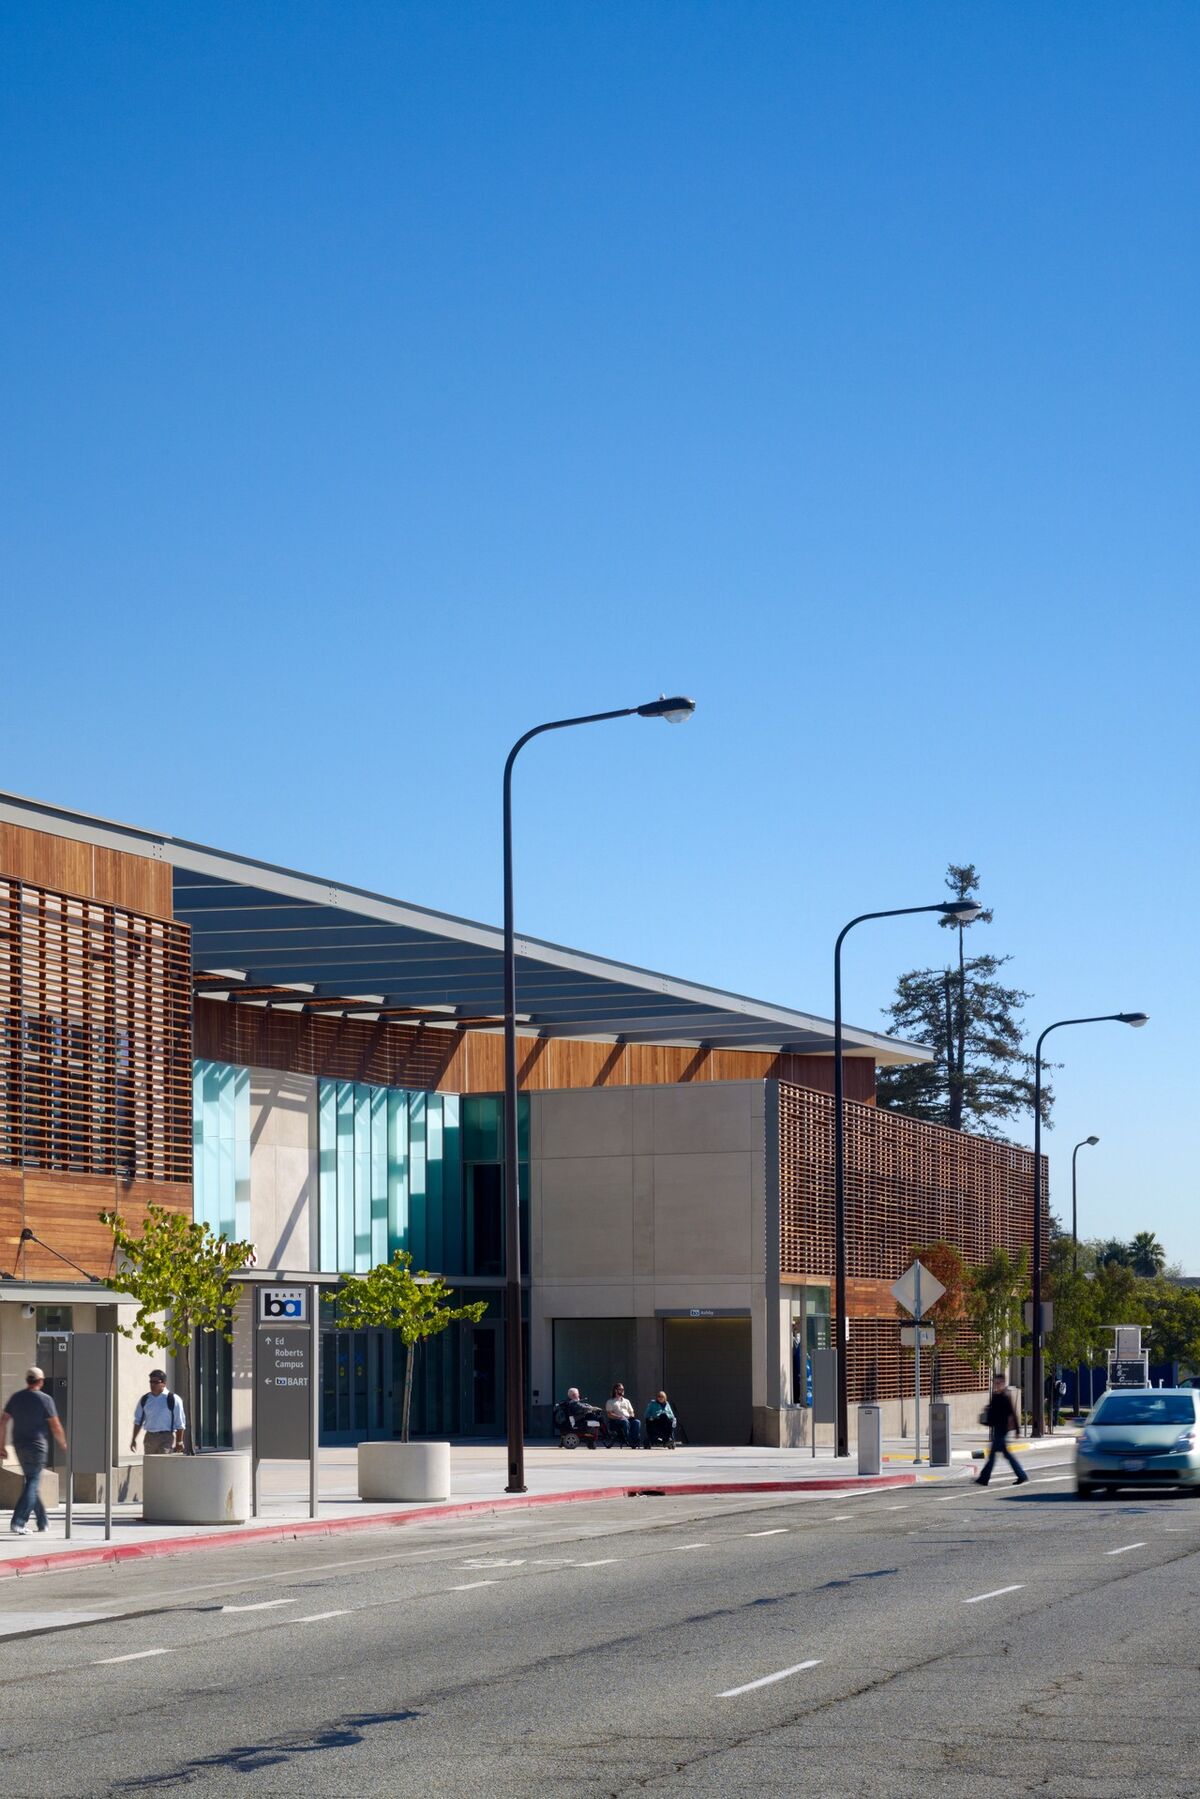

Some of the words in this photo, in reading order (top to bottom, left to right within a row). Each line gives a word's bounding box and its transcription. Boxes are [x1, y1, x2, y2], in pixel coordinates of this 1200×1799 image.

[275, 1337, 285, 1345] Ed
[275, 1348, 304, 1357] Roberts
[275, 1360, 304, 1370] Campus
[287, 1377, 308, 1386] BART
